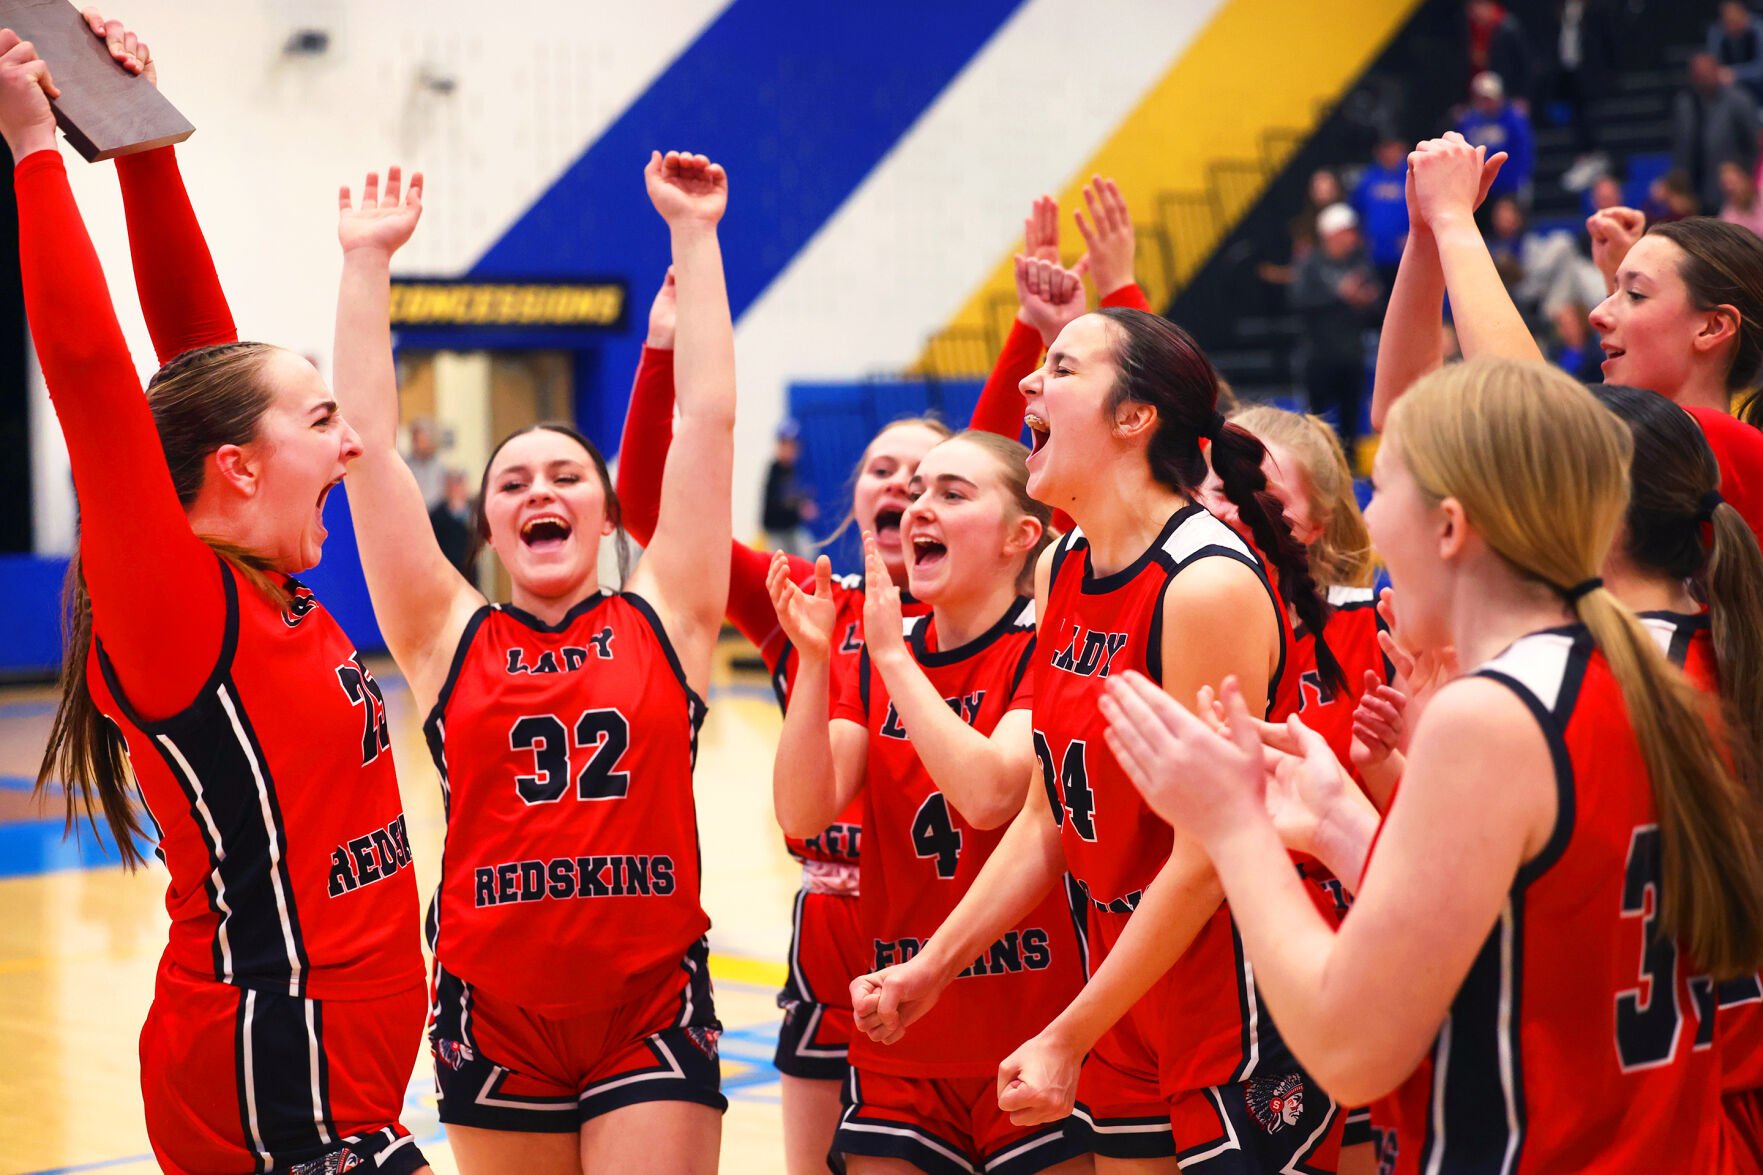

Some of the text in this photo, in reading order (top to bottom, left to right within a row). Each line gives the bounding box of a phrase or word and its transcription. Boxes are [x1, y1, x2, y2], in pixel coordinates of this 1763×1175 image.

[507, 626, 614, 675] LADY
[880, 690, 986, 740] LY
[509, 707, 630, 806] 32
[910, 791, 963, 879] 4
[474, 855, 676, 909] REDSKINS
[868, 928, 1052, 979] EDINS
[1614, 823, 1714, 1074] 3
[1272, 1100, 1281, 1110] S
